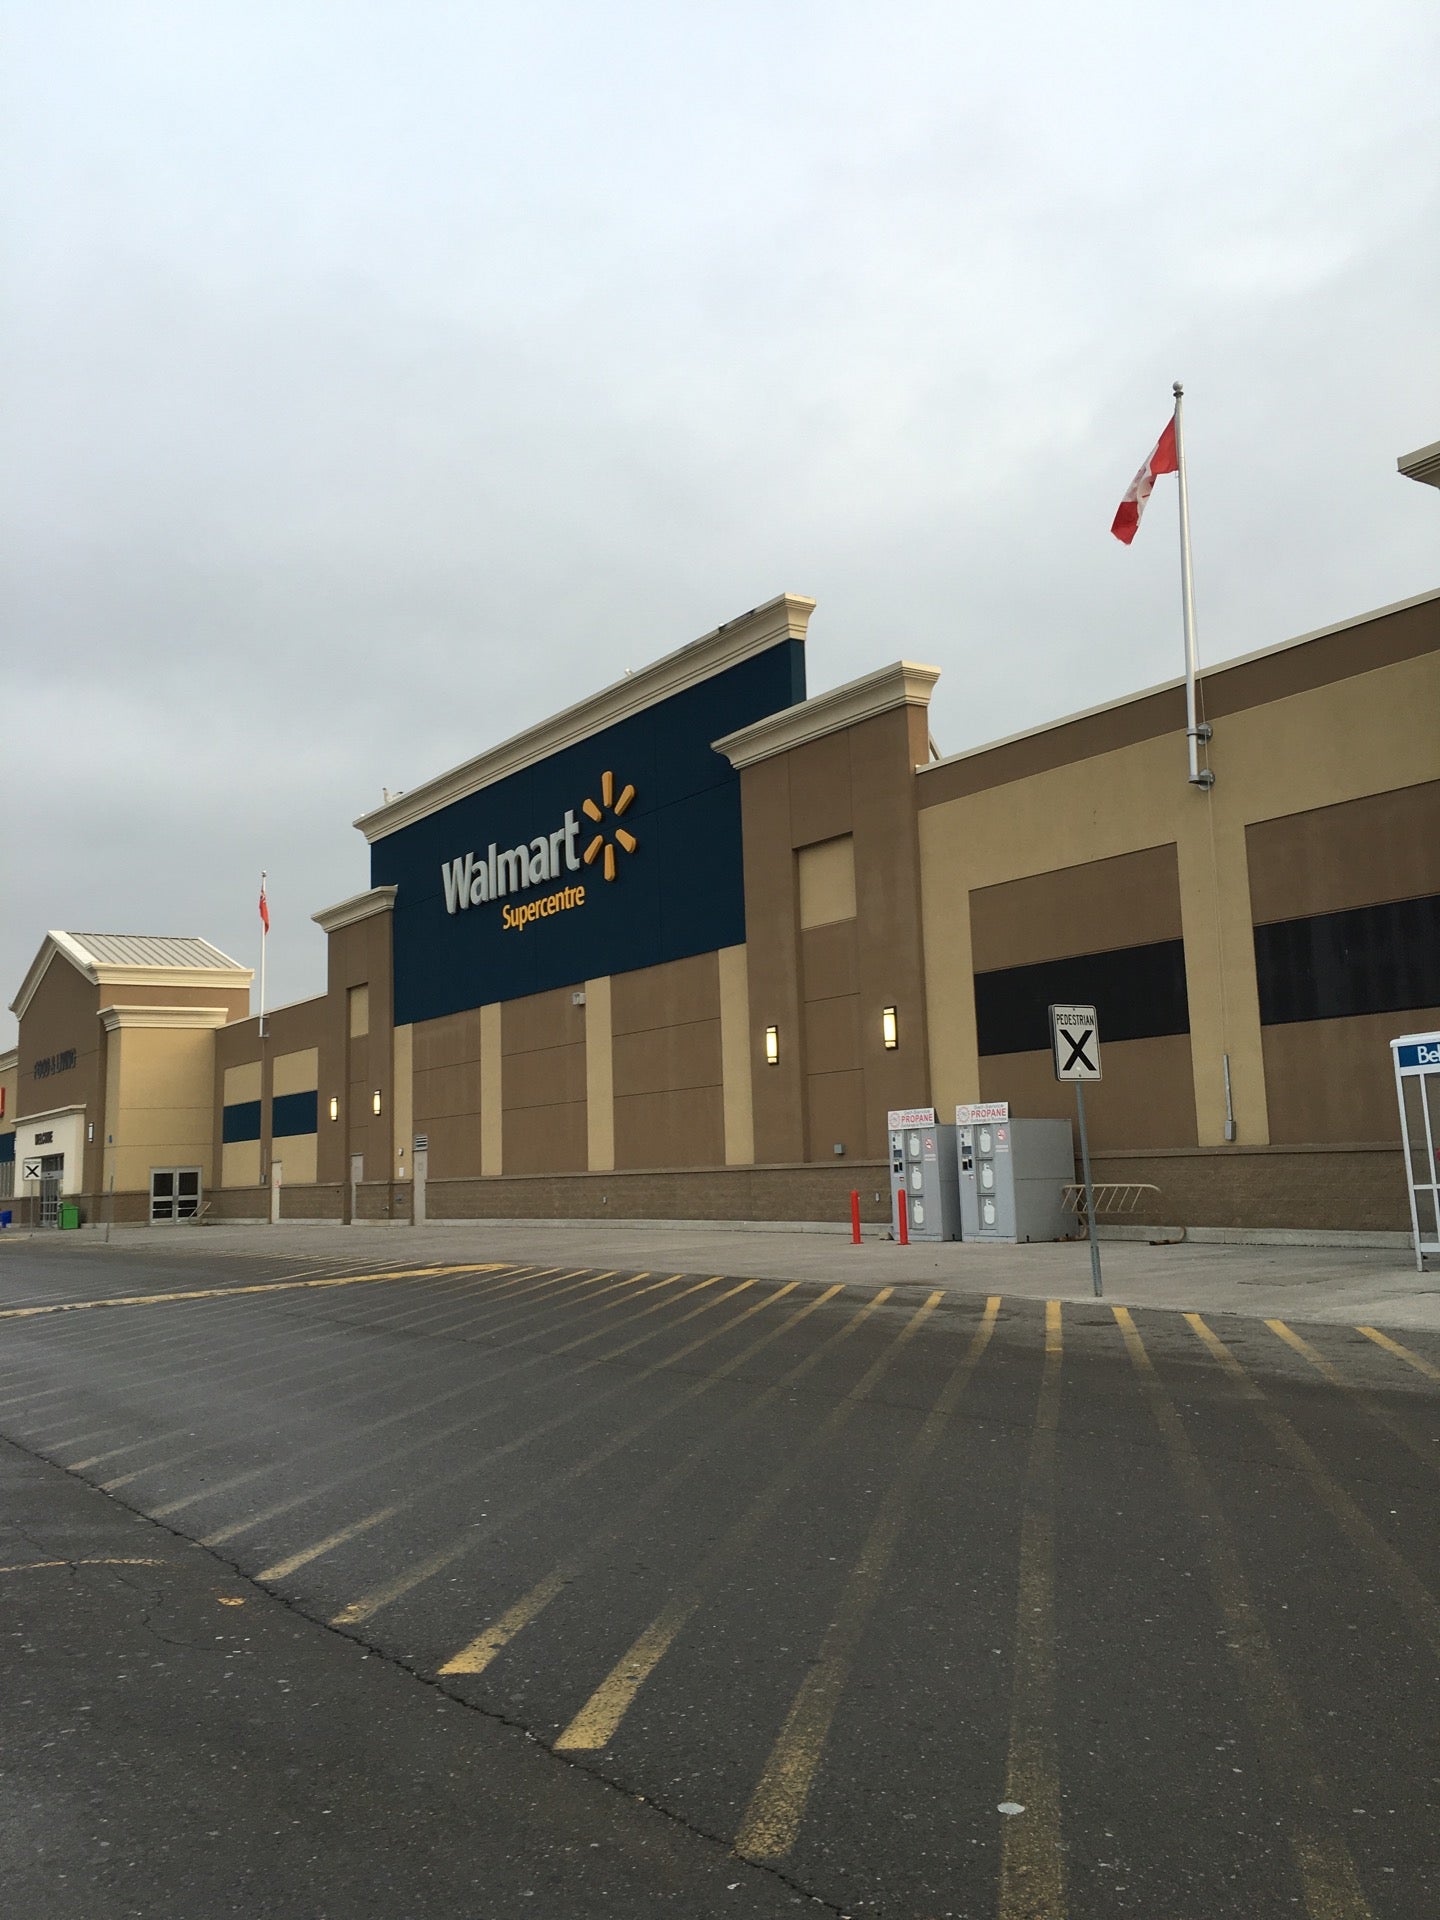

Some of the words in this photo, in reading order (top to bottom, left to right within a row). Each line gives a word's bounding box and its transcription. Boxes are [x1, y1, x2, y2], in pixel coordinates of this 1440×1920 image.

[441, 809, 581, 915] Walmart
[502, 885, 586, 932] Supercentre
[1056, 1014, 1095, 1025] PEDESTRIAN
[1059, 1029, 1097, 1071] X
[901, 1114, 933, 1123] PROPANE
[970, 1108, 1007, 1118] PROPANE
